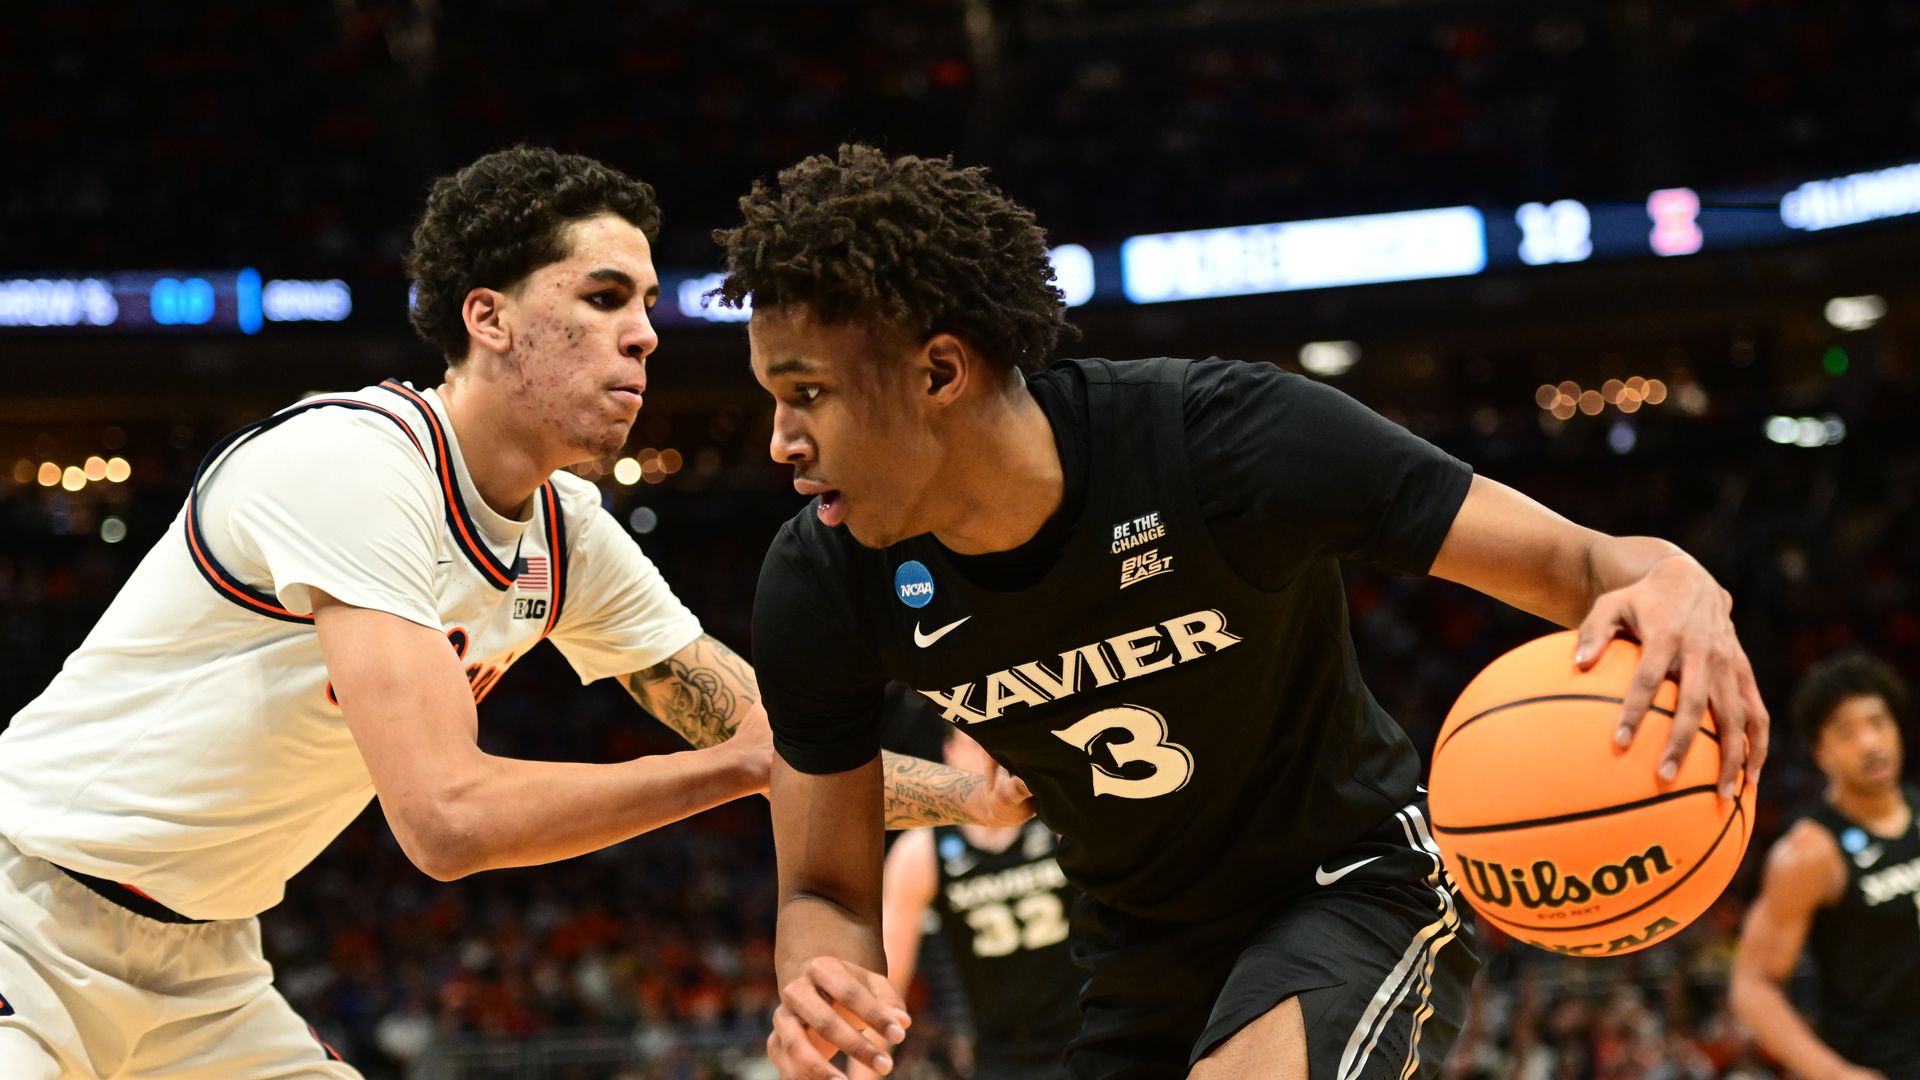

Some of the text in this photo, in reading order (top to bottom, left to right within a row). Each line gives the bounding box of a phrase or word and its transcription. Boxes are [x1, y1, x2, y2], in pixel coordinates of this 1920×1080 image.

[1111, 524, 1166, 554] CHANGE
[1113, 512, 1159, 540] BE THE
[1120, 556, 1174, 584] EAST
[1121, 548, 1159, 573] BIG
[900, 582, 934, 598] NCAA
[917, 608, 1243, 724] XAVIER
[1050, 703, 1195, 800] 3
[1456, 845, 1673, 908] Wilson
[1570, 904, 1602, 917] NXT
[965, 893, 1070, 958] 32
